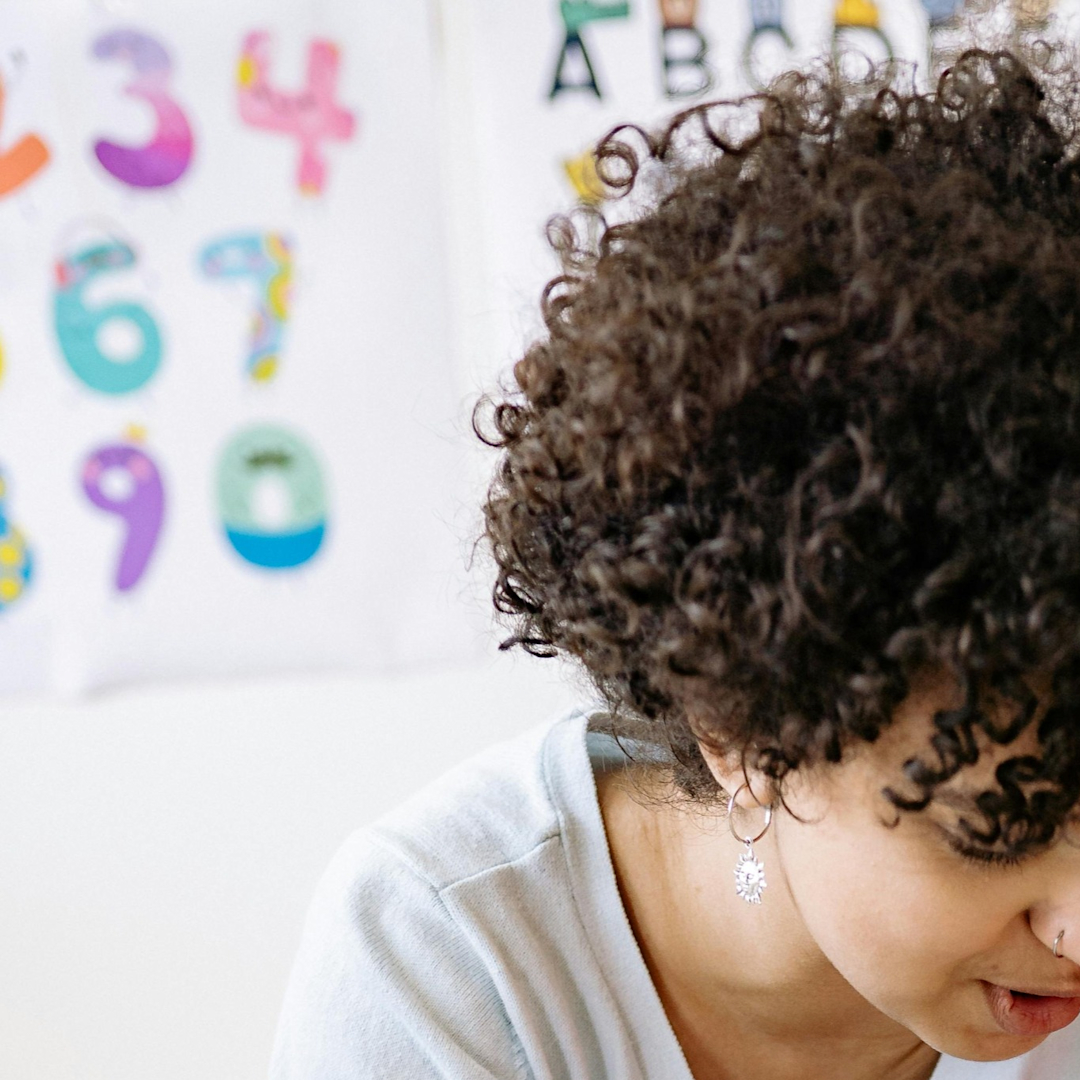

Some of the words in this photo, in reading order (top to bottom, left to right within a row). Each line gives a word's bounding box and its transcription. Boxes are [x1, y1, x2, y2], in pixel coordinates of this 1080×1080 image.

[91, 27, 197, 192] 3
[234, 28, 359, 198] 4
[547, 24, 605, 101] A
[660, 24, 713, 99] B
[48, 236, 168, 399] 6
[194, 228, 296, 386] 7
[76, 436, 172, 597] 9
[211, 419, 334, 577] 0
